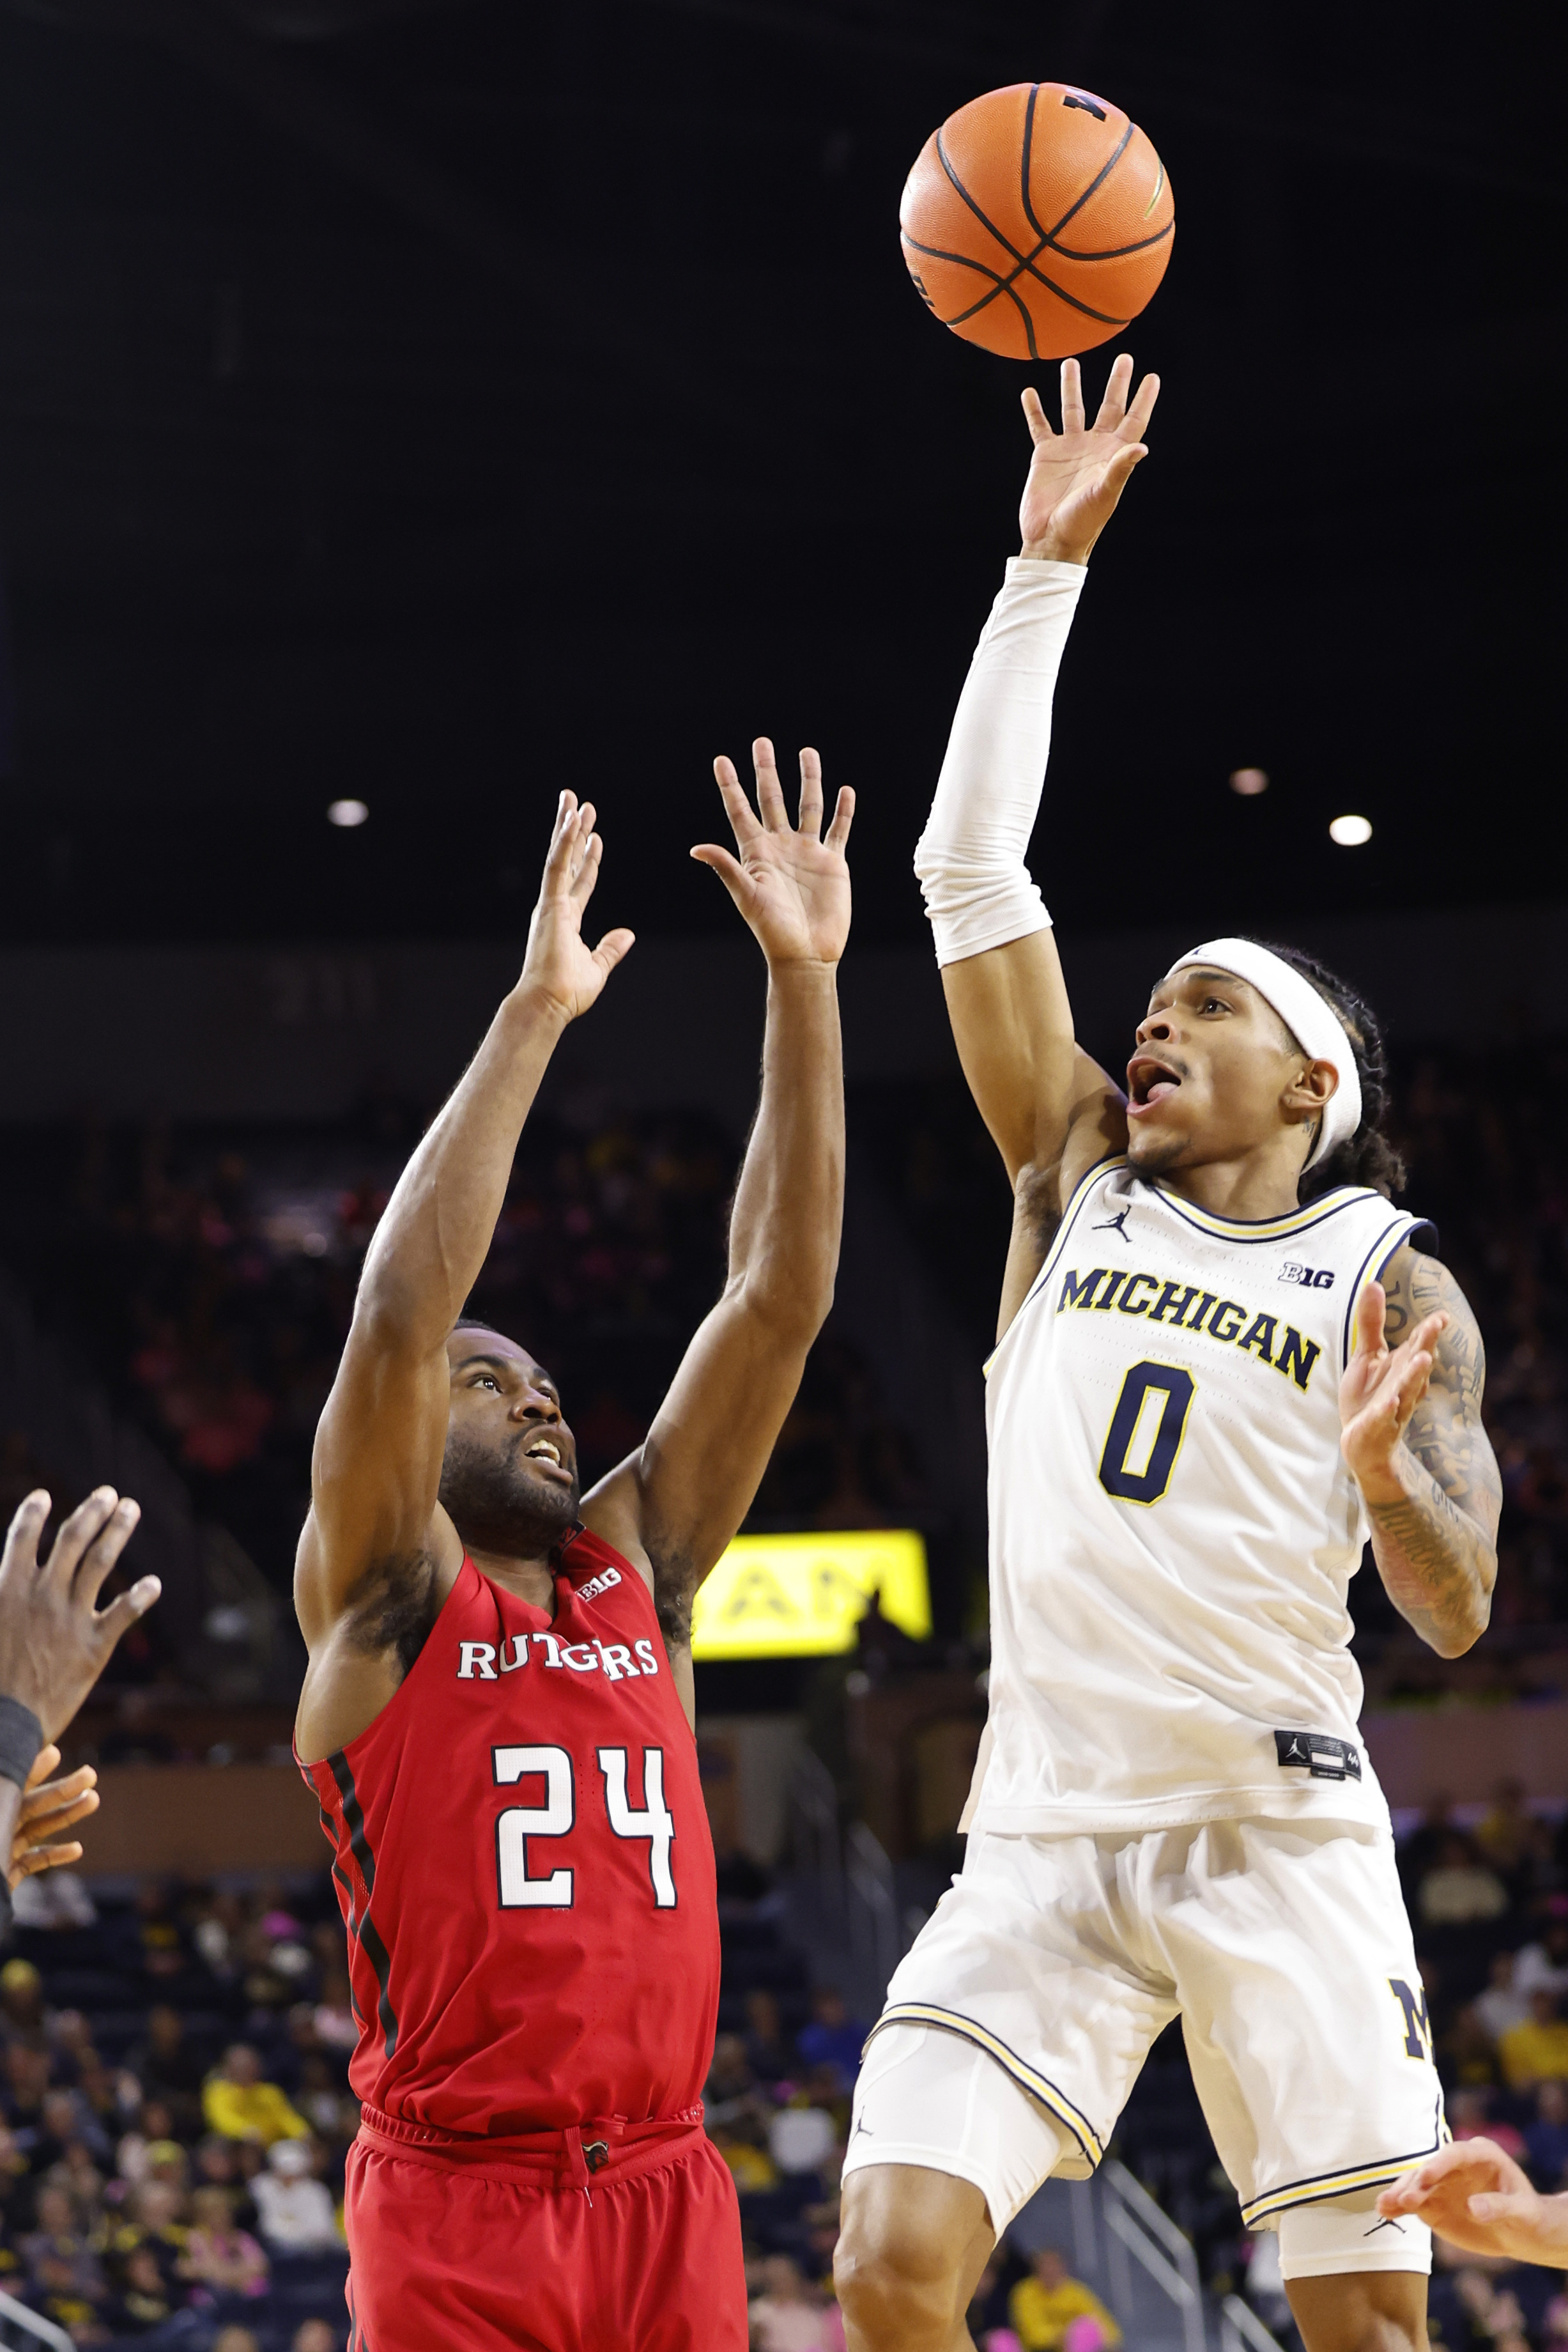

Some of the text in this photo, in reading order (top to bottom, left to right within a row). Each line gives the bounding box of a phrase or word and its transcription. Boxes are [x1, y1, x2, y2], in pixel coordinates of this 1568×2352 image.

[1055, 1268, 1322, 1394] MICHIGAN
[1098, 1359, 1198, 1507] 0
[490, 1745, 678, 1910] 24
